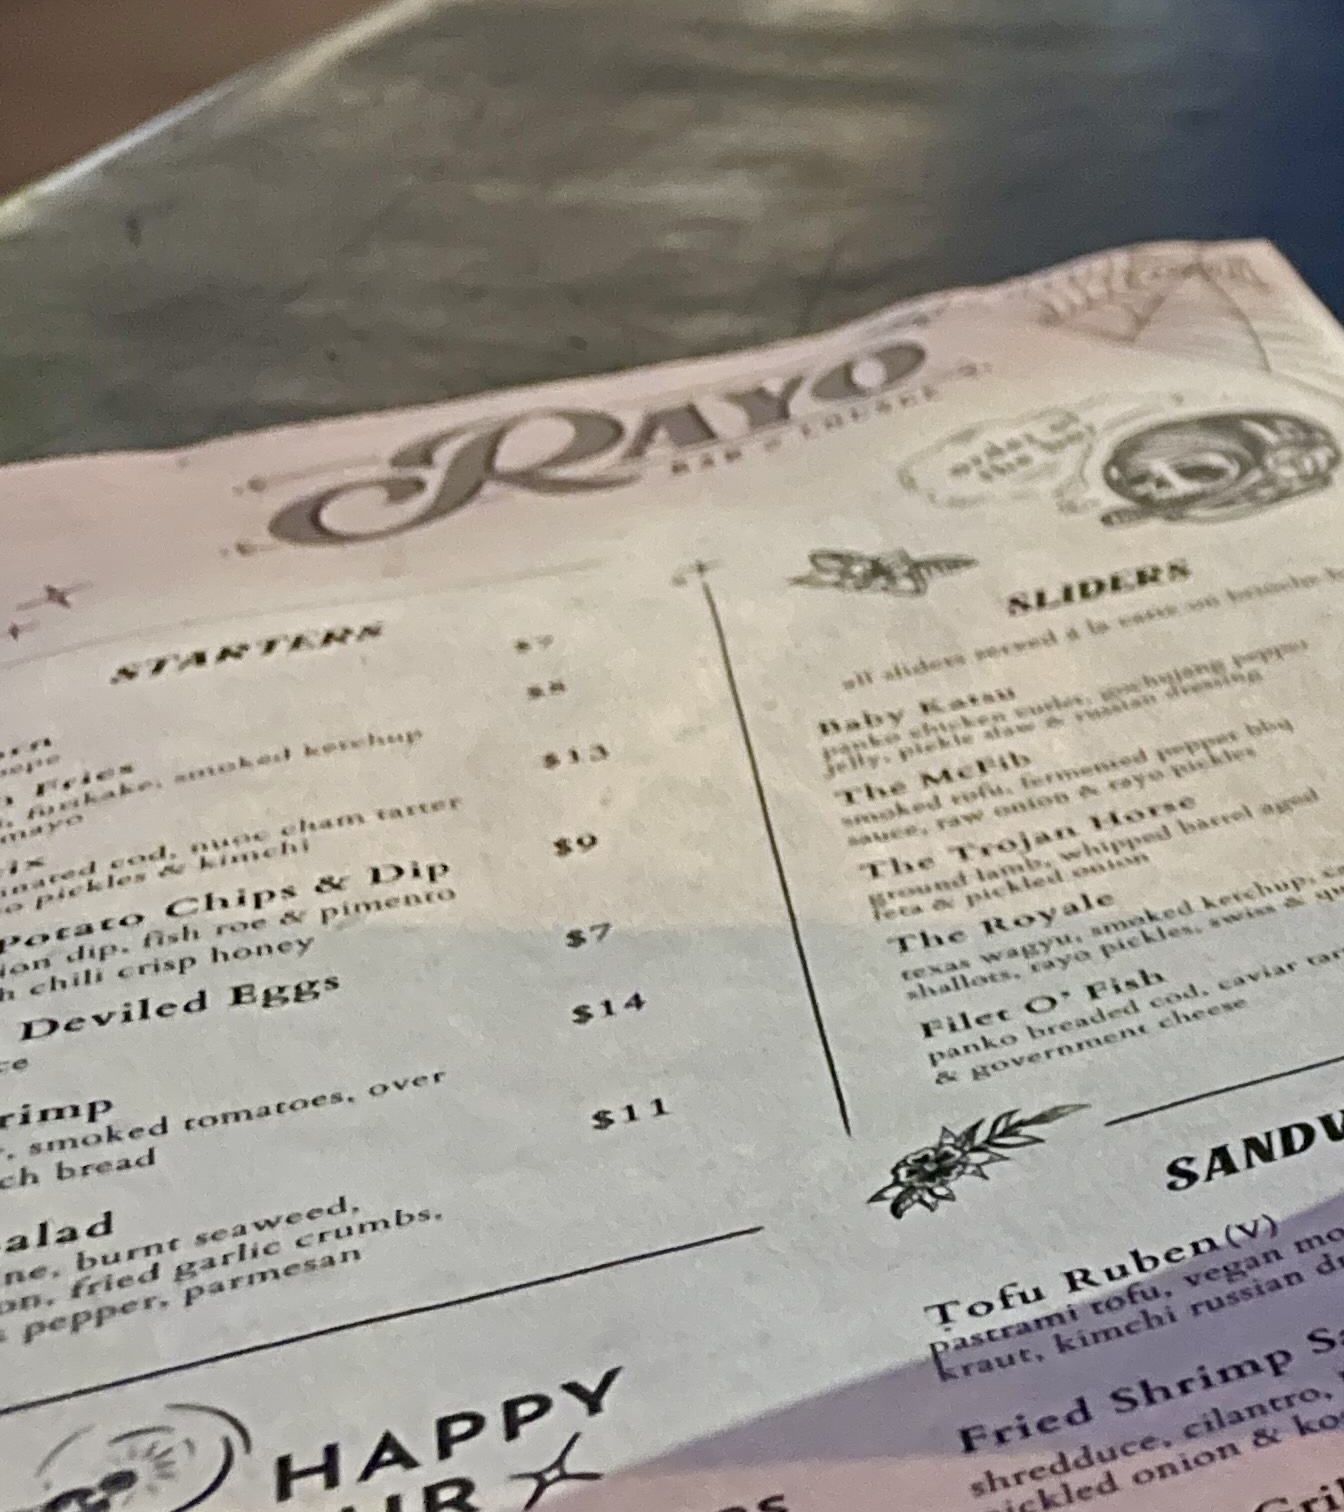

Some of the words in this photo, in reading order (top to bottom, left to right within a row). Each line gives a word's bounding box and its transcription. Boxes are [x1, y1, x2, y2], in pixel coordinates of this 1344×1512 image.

[1007, 557, 1192, 618] SLIDERS
[109, 619, 385, 685] STARTERS
[818, 709, 905, 737] Baby
[832, 781, 908, 806] The
[840, 793, 943, 827] smoked
[935, 808, 984, 832] raw
[857, 855, 936, 880] The
[946, 824, 1079, 863] Trojan
[1089, 795, 1197, 831] Horse
[165, 884, 298, 918] Chips
[314, 873, 350, 895] &
[368, 859, 451, 886] Dip
[144, 924, 200, 949] fish
[279, 909, 306, 926] &
[565, 921, 612, 948] $7
[886, 928, 968, 954] The
[980, 892, 1116, 936] Royale
[899, 958, 972, 982] texas
[979, 932, 1085, 965] wagyu,
[1090, 898, 1194, 939] smoked
[1200, 874, 1316, 911] ketchup,
[1030, 949, 1093, 975] rayo
[1208, 904, 1277, 929] swiss
[30, 967, 104, 996] chili
[118, 956, 197, 979] crisp
[211, 936, 315, 964] honey
[20, 989, 207, 1041] Deviled
[228, 975, 341, 1009] Eggs
[571, 991, 648, 1026] $14
[919, 1008, 1012, 1039] Filet
[1085, 967, 1169, 1002] Fish
[927, 1034, 1019, 1069] panko
[1025, 998, 1141, 1041] breaded
[1217, 961, 1299, 993] caviar
[934, 1069, 961, 1087] &
[971, 1023, 1148, 1083] government
[1157, 996, 1249, 1031] cheese
[29, 1115, 169, 1156] smoked
[184, 1088, 356, 1131] tomatoes,
[367, 1068, 447, 1098] over
[591, 1096, 673, 1133] $11
[56, 1146, 156, 1182] bread
[71, 1261, 160, 1300] fried
[173, 1240, 282, 1283] garlic
[295, 1207, 444, 1249] crumbs,
[76, 1237, 181, 1272] burnt
[193, 1195, 361, 1246] seaweed,
[23, 1295, 169, 1345] pepper,
[184, 1246, 363, 1308] parmesan
[922, 1282, 1048, 1327] Tofu
[927, 1303, 1080, 1362] pastrami
[1091, 1283, 1174, 1317] tofu,
[1183, 1245, 1284, 1290] vegan
[933, 1348, 1044, 1383] kraut,
[1054, 1305, 1179, 1355] kimchi
[1190, 1268, 1305, 1318] russian
[956, 1395, 1094, 1454] Fried
[1108, 1346, 1295, 1416] Shrimp
[275, 1365, 624, 1503] HAPPY
[969, 1428, 1173, 1499] shredduce,
[1183, 1385, 1334, 1441] cilantro,
[1131, 1440, 1242, 1489] onion
[1251, 1427, 1282, 1449] &
